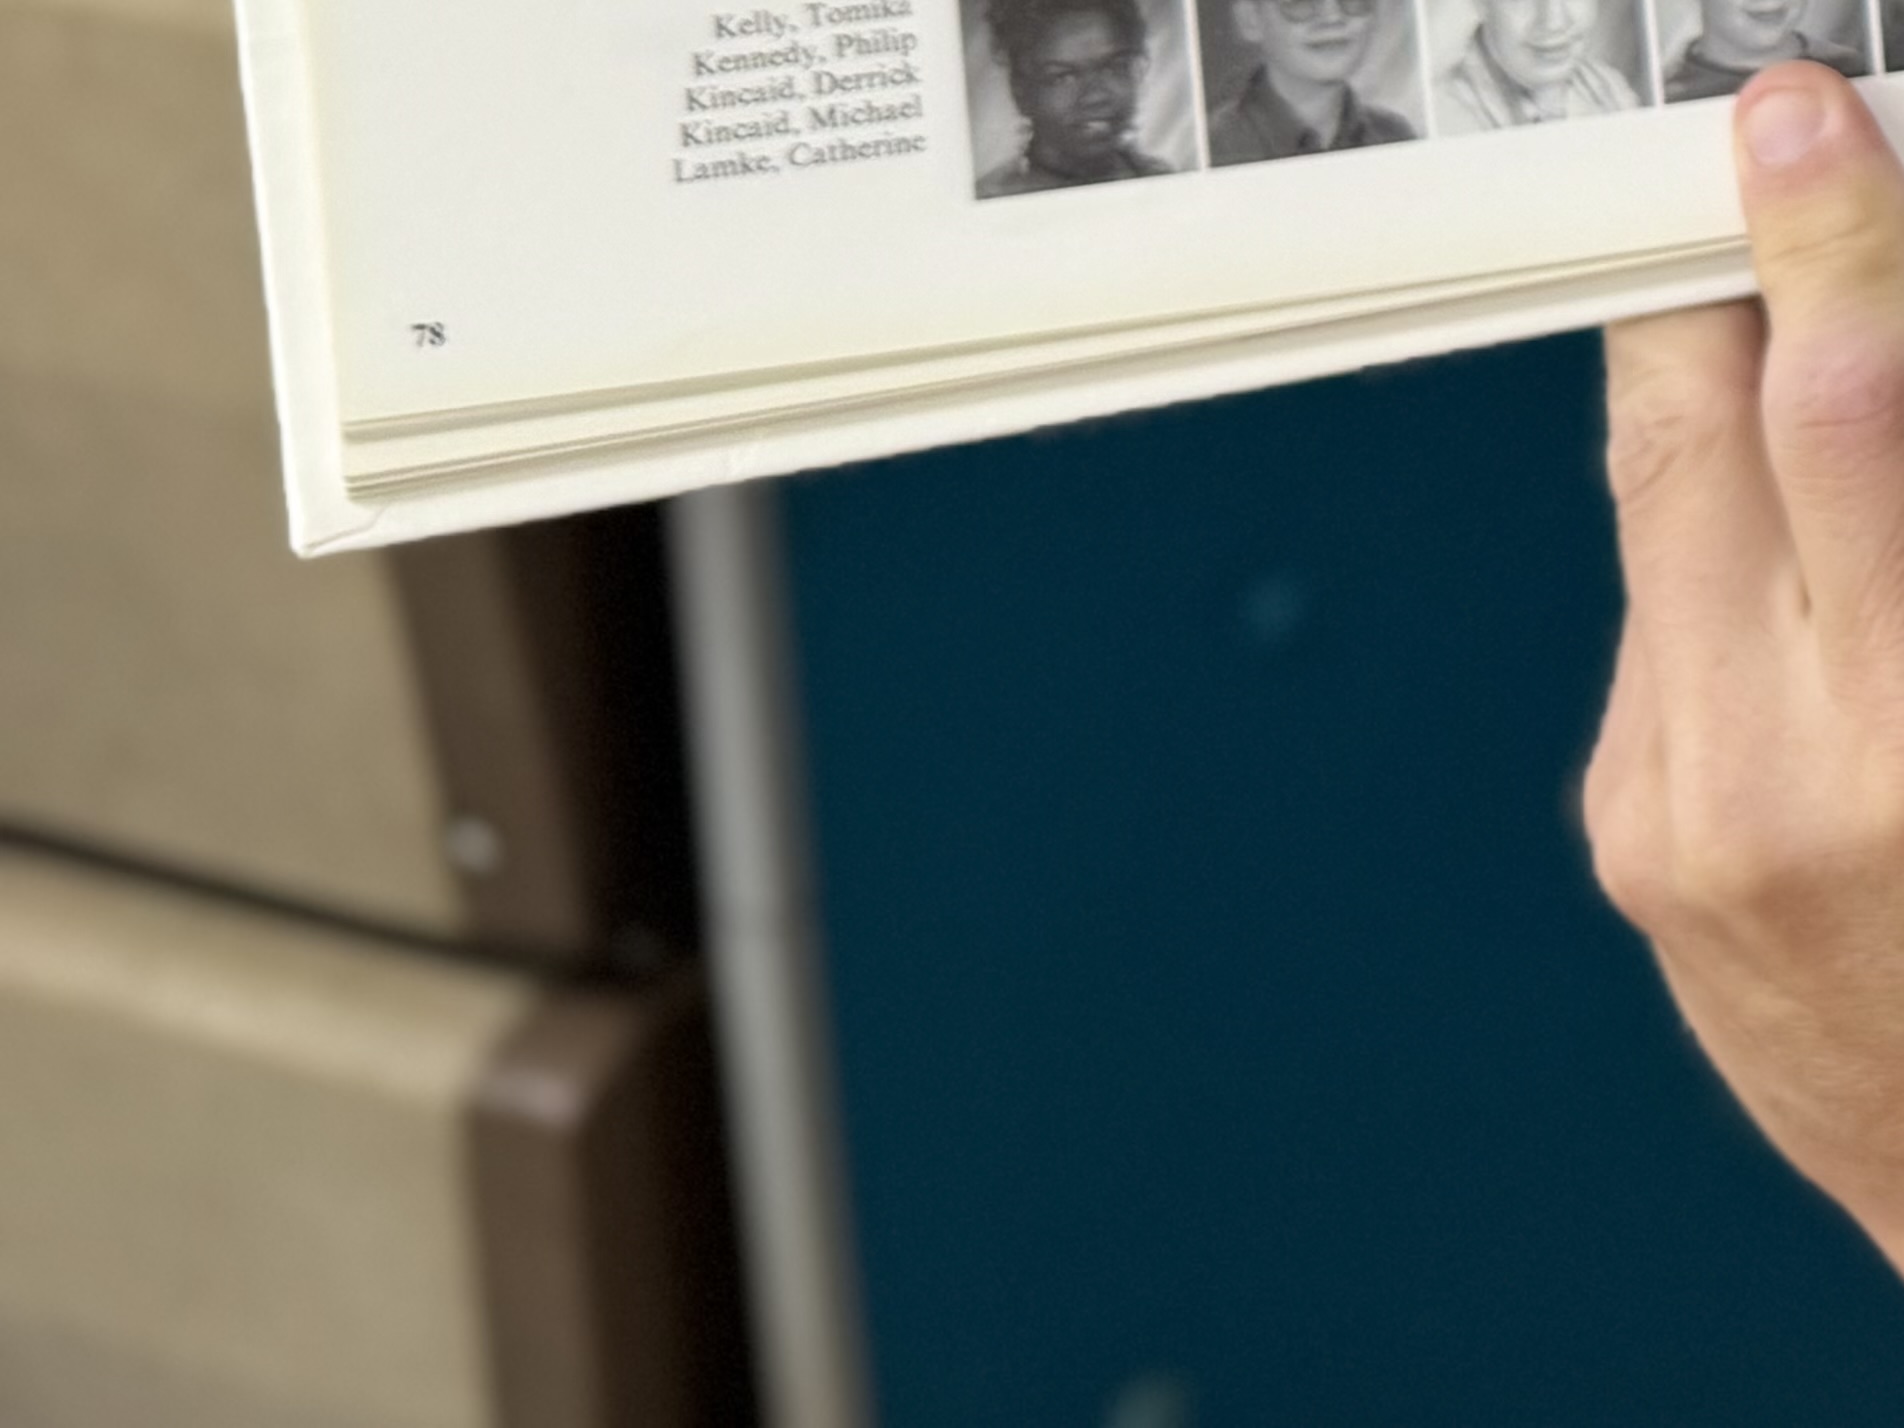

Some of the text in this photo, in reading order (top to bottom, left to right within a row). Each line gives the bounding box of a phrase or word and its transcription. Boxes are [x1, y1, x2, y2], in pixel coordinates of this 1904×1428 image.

[710, 10, 800, 38] Kelly,
[690, 28, 917, 76] Kennedy, Philip
[684, 62, 921, 111] Kincaid, Derrick
[679, 95, 923, 147] Kincaid, Michael
[787, 133, 927, 166] Catherine
[411, 322, 446, 347] 78
